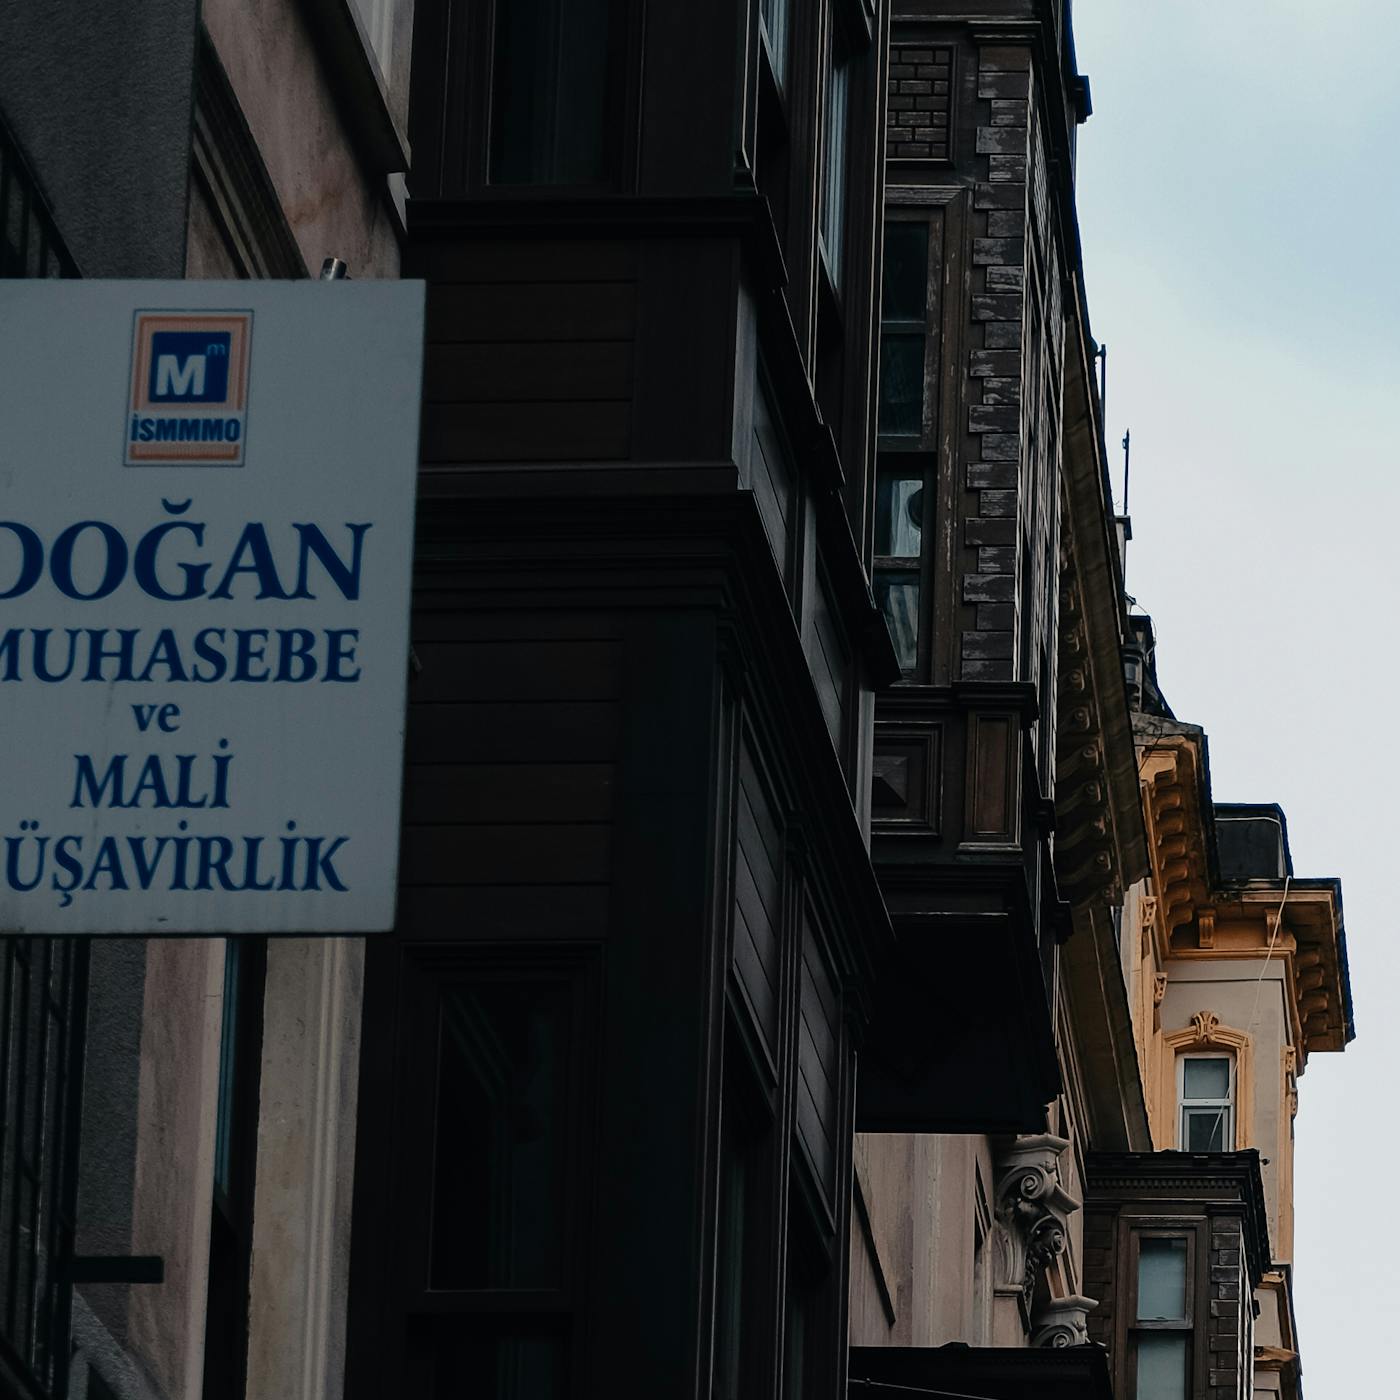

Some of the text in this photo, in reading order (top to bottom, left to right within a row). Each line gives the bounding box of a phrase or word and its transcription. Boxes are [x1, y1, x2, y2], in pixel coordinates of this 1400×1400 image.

[131, 413, 240, 441] İSMMMO
[132, 703, 181, 733] ve
[69, 738, 234, 809] MALİ
